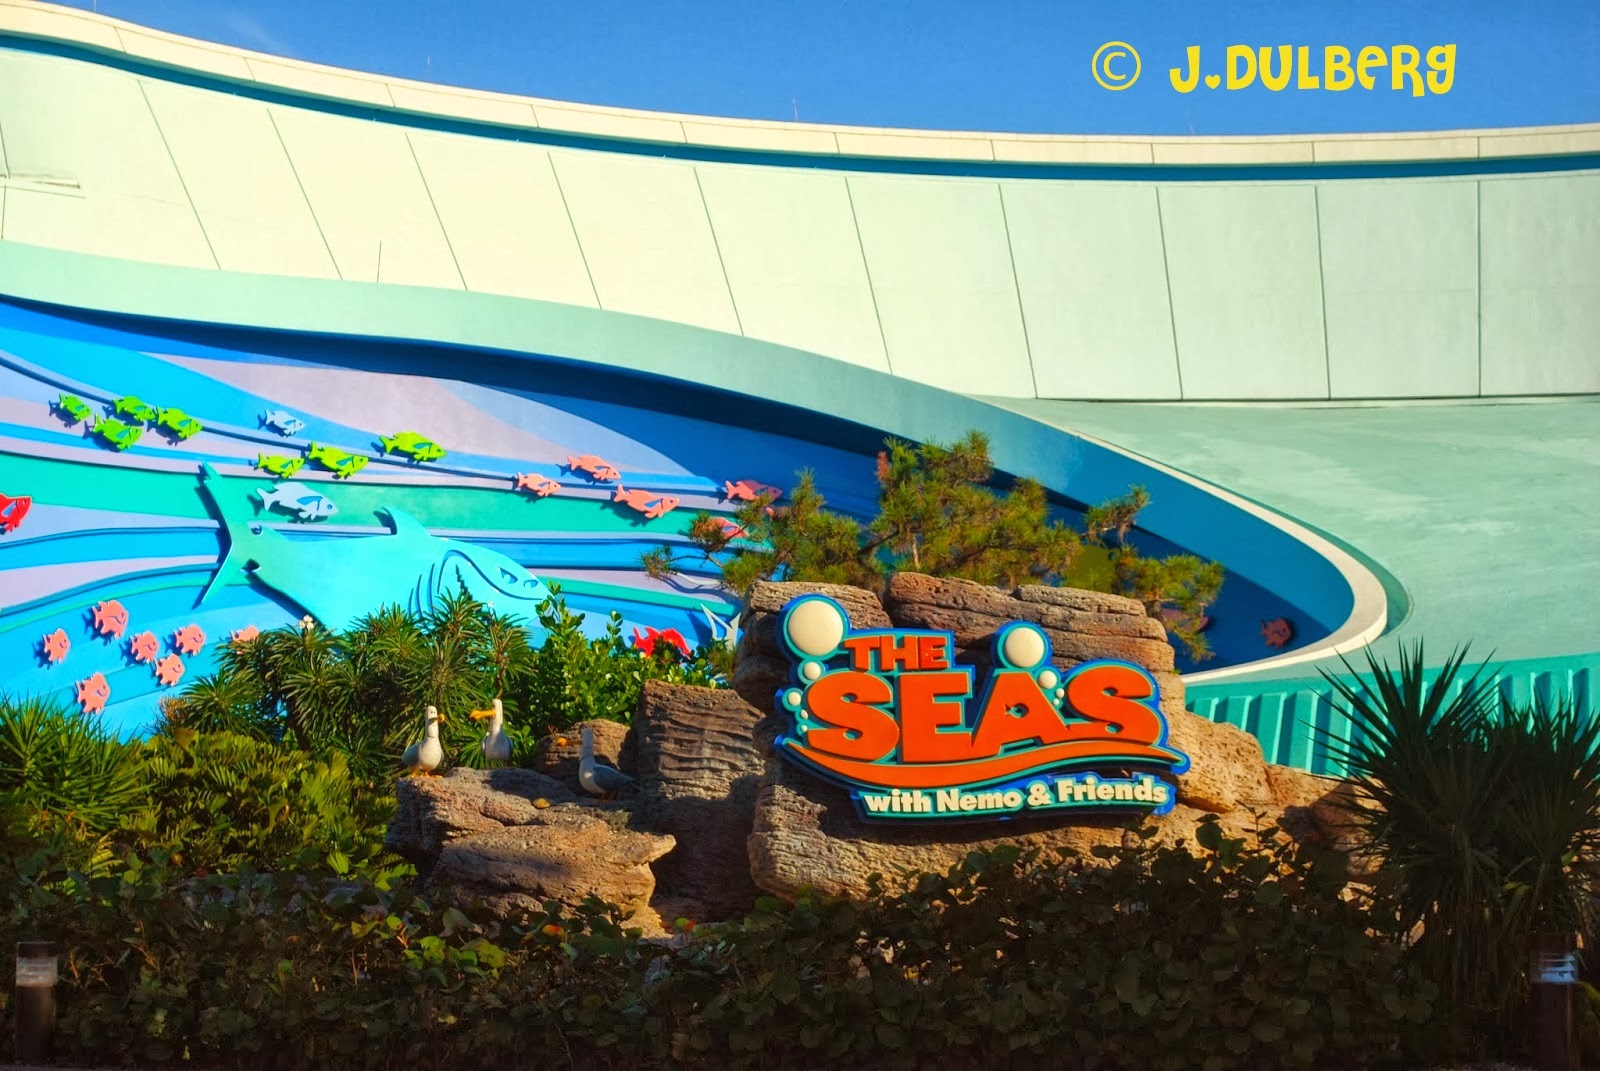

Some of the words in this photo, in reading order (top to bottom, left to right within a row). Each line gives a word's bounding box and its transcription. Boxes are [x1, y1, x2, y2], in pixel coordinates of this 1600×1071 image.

[844, 635, 949, 671] THE
[806, 665, 1162, 764] SEAS
[863, 789, 931, 814] with
[936, 788, 1022, 812] Nemo
[1026, 783, 1053, 808] &
[1057, 775, 1169, 804] Friends
